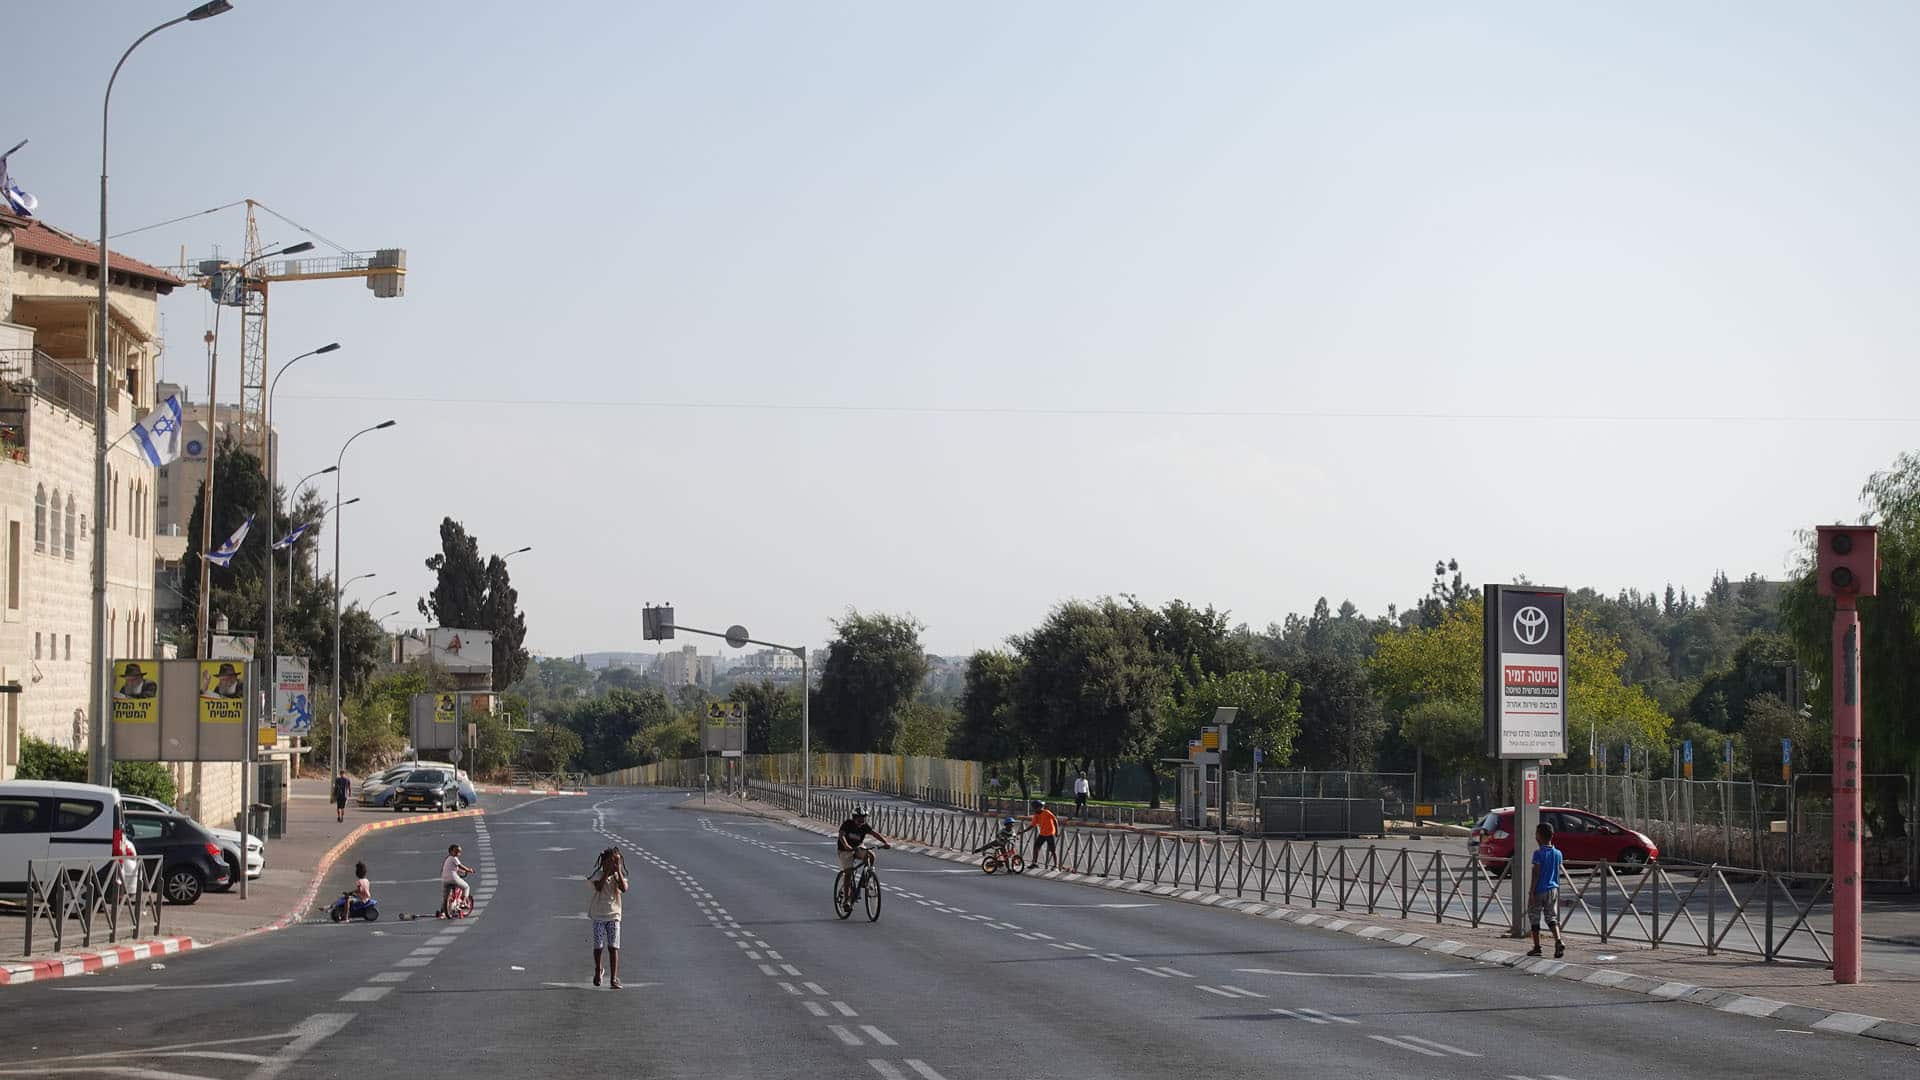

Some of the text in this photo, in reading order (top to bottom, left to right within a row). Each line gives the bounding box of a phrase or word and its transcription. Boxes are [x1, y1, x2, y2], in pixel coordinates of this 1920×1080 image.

[1506, 670, 1558, 683] טויוטה זמיר
[113, 701, 151, 711] יחי המלך
[206, 700, 242, 710] חי המלך
[115, 710, 146, 719] המשיח
[209, 710, 240, 718] המשיח
